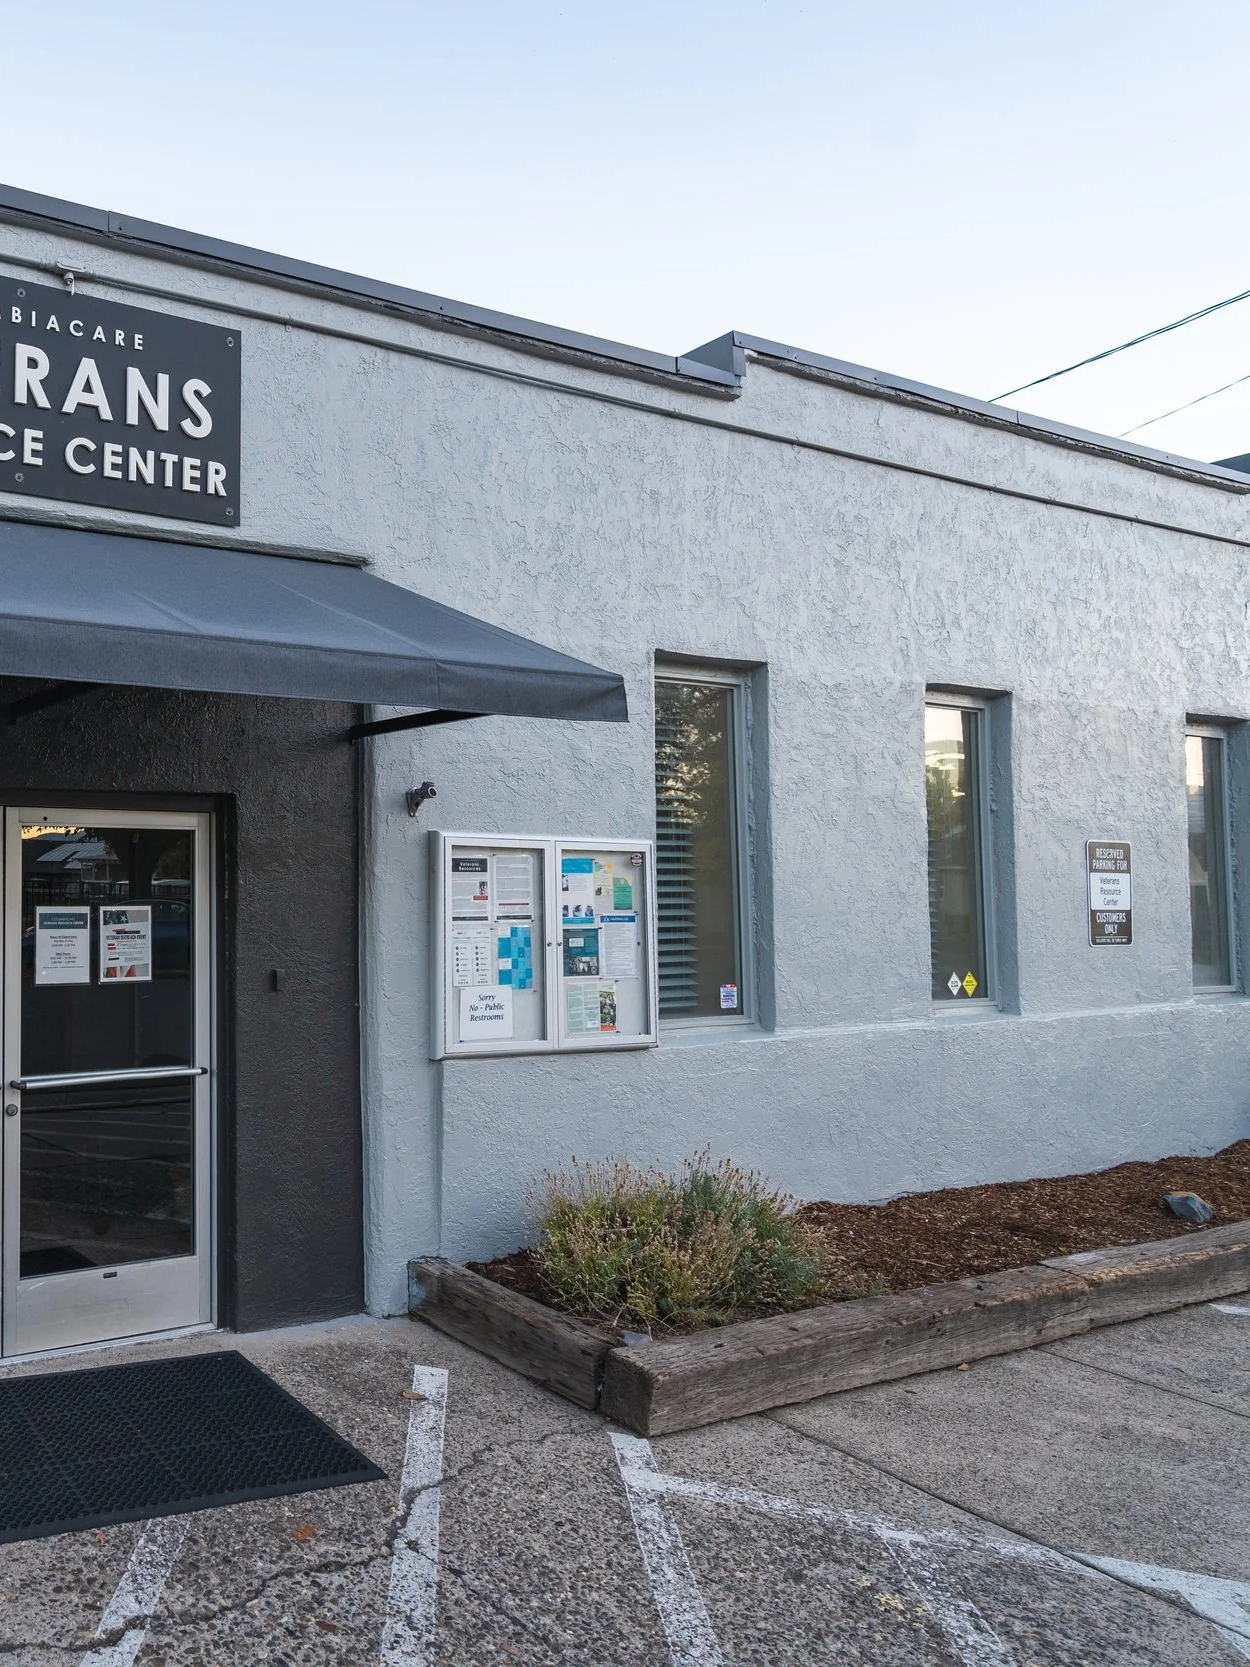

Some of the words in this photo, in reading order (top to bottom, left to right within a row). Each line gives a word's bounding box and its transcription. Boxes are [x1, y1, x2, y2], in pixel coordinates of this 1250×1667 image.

[65, 437, 228, 497] CENTER
[1095, 848, 1124, 859] RESERVED
[1092, 859, 1115, 870] PARKING
[1116, 860, 1128, 871] FOR
[1099, 877, 1120, 885] Veterans
[1100, 887, 1121, 896] Resource
[1103, 898, 1119, 906] Center
[1096, 912, 1126, 923] CUSTOMERS
[1104, 924, 1118, 934] ONLY
[478, 994, 496, 1002] Sorry
[469, 1004, 479, 1012] No
[485, 1003, 505, 1011] Public
[470, 1013, 504, 1022] Restrooms
